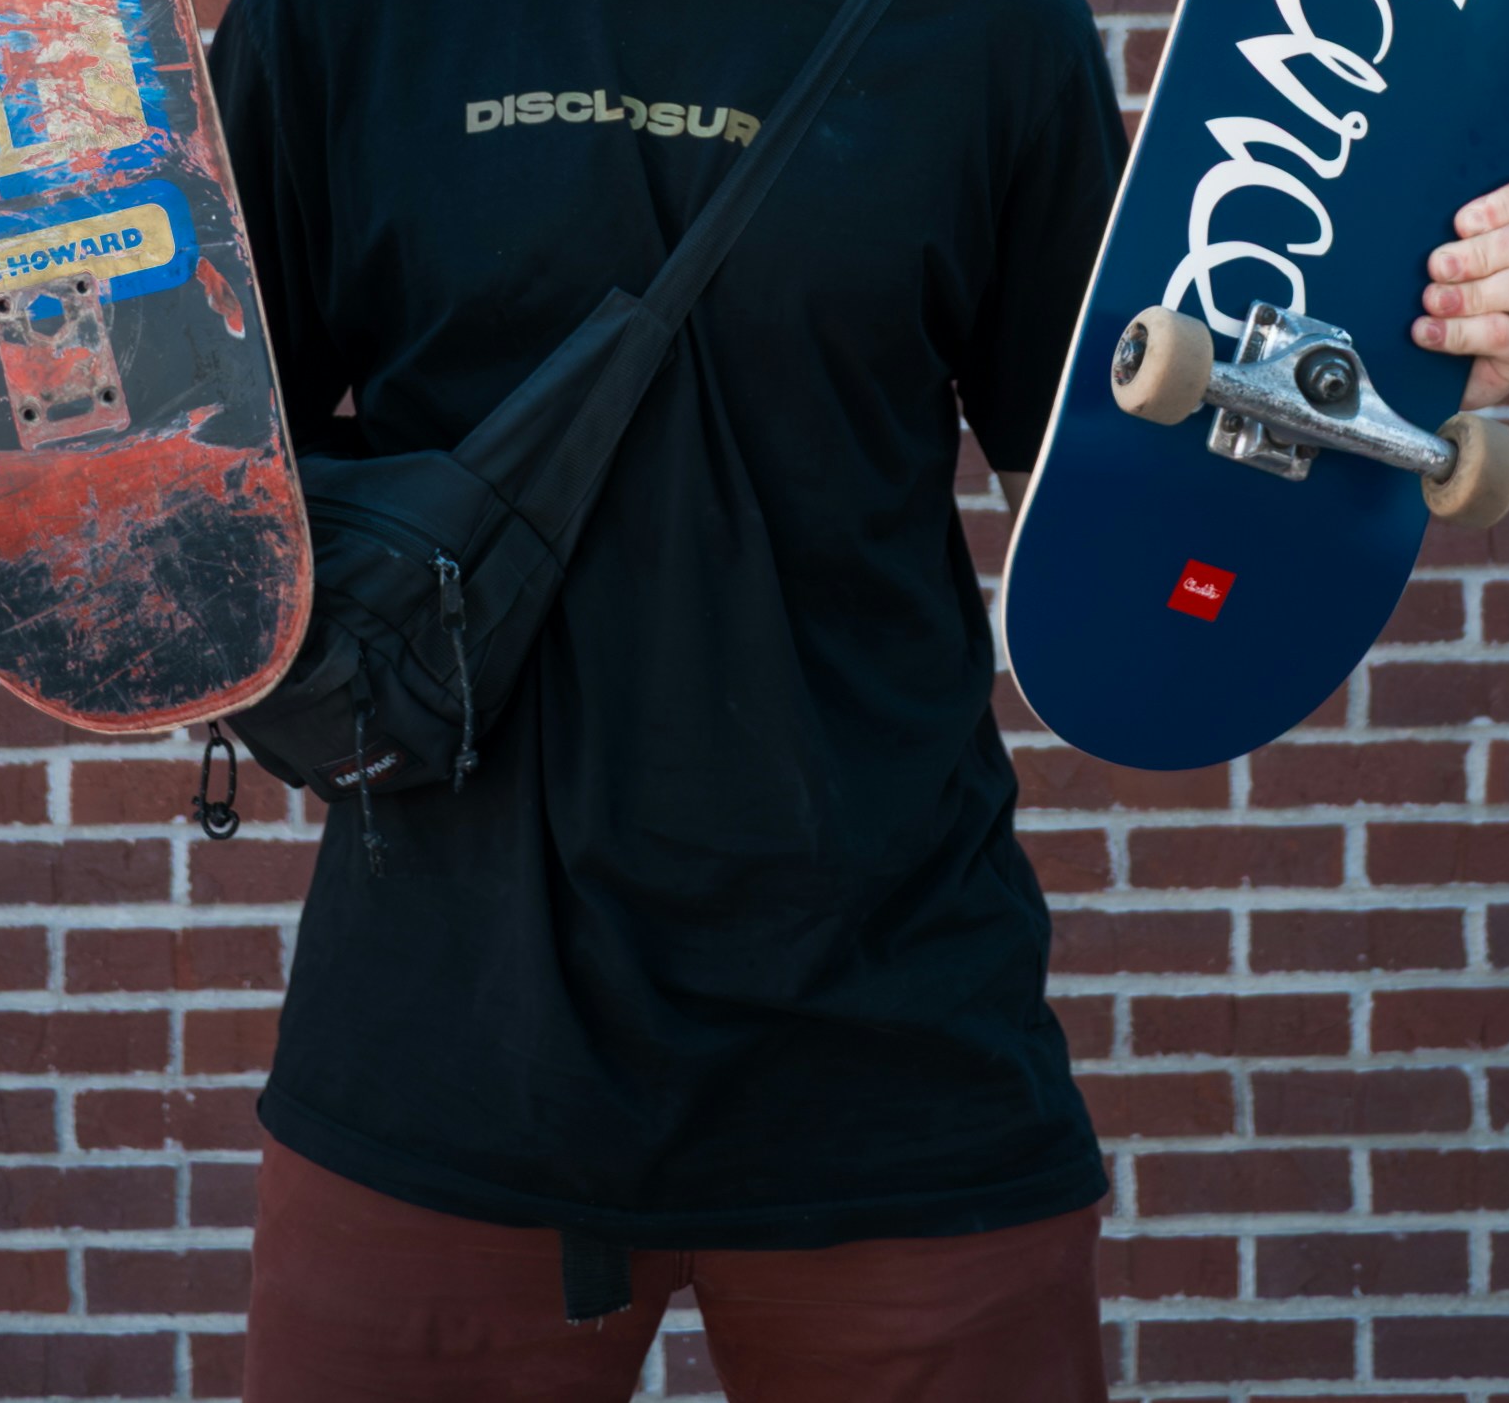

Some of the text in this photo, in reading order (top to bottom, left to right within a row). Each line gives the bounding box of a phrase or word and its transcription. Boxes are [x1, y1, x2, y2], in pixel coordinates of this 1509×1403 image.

[466, 89, 762, 147] DISCLOSUR
[7, 227, 144, 276] HOWARD
[335, 754, 397, 786] EASPAK
